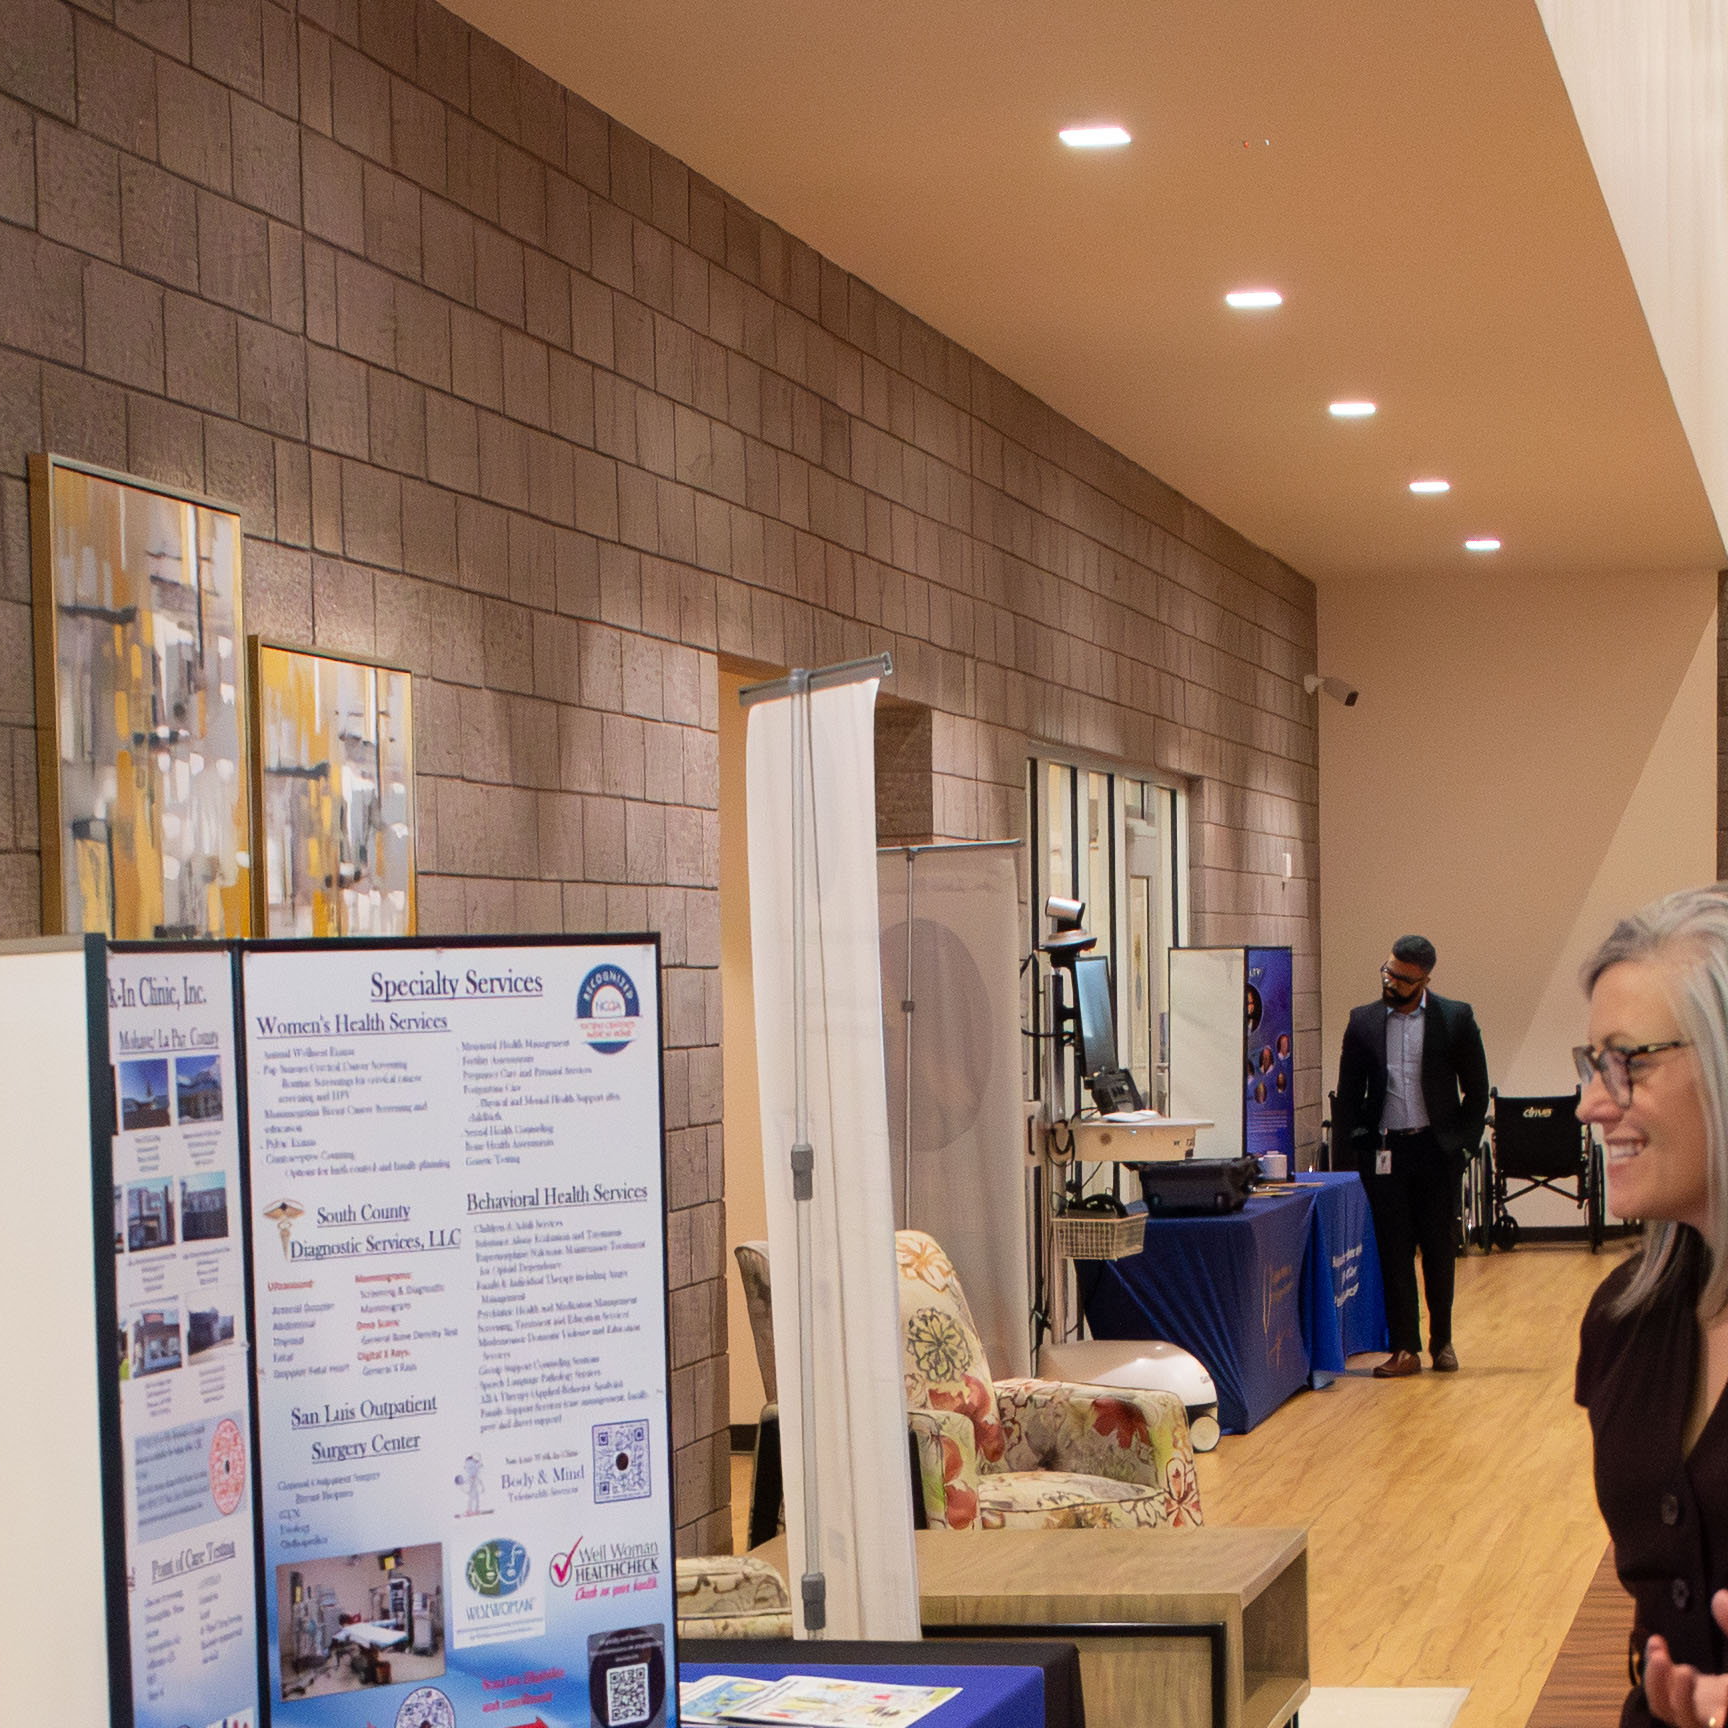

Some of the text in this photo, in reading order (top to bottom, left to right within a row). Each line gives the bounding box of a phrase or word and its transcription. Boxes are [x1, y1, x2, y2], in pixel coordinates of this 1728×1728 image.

[139, 975, 180, 1010] Clinic,
[184, 975, 207, 1005] Inc.
[371, 968, 543, 1002] Specialty Services
[583, 970, 633, 1000] RECOGNIZED
[257, 1011, 448, 1035] Women's Health Services
[467, 1182, 648, 1212] Behavioral Health Services
[317, 1204, 411, 1225] South County
[290, 1237, 362, 1260] Diagnostic
[366, 1233, 424, 1252] Services,
[430, 1228, 461, 1247] LLC
[291, 1395, 438, 1428] San Luis Outpatient
[311, 1433, 421, 1461] Surgery Center
[501, 1464, 585, 1490] Body & Mind
[579, 1542, 658, 1563] Well Woman
[576, 1557, 658, 1583] HEALTHCHECK
